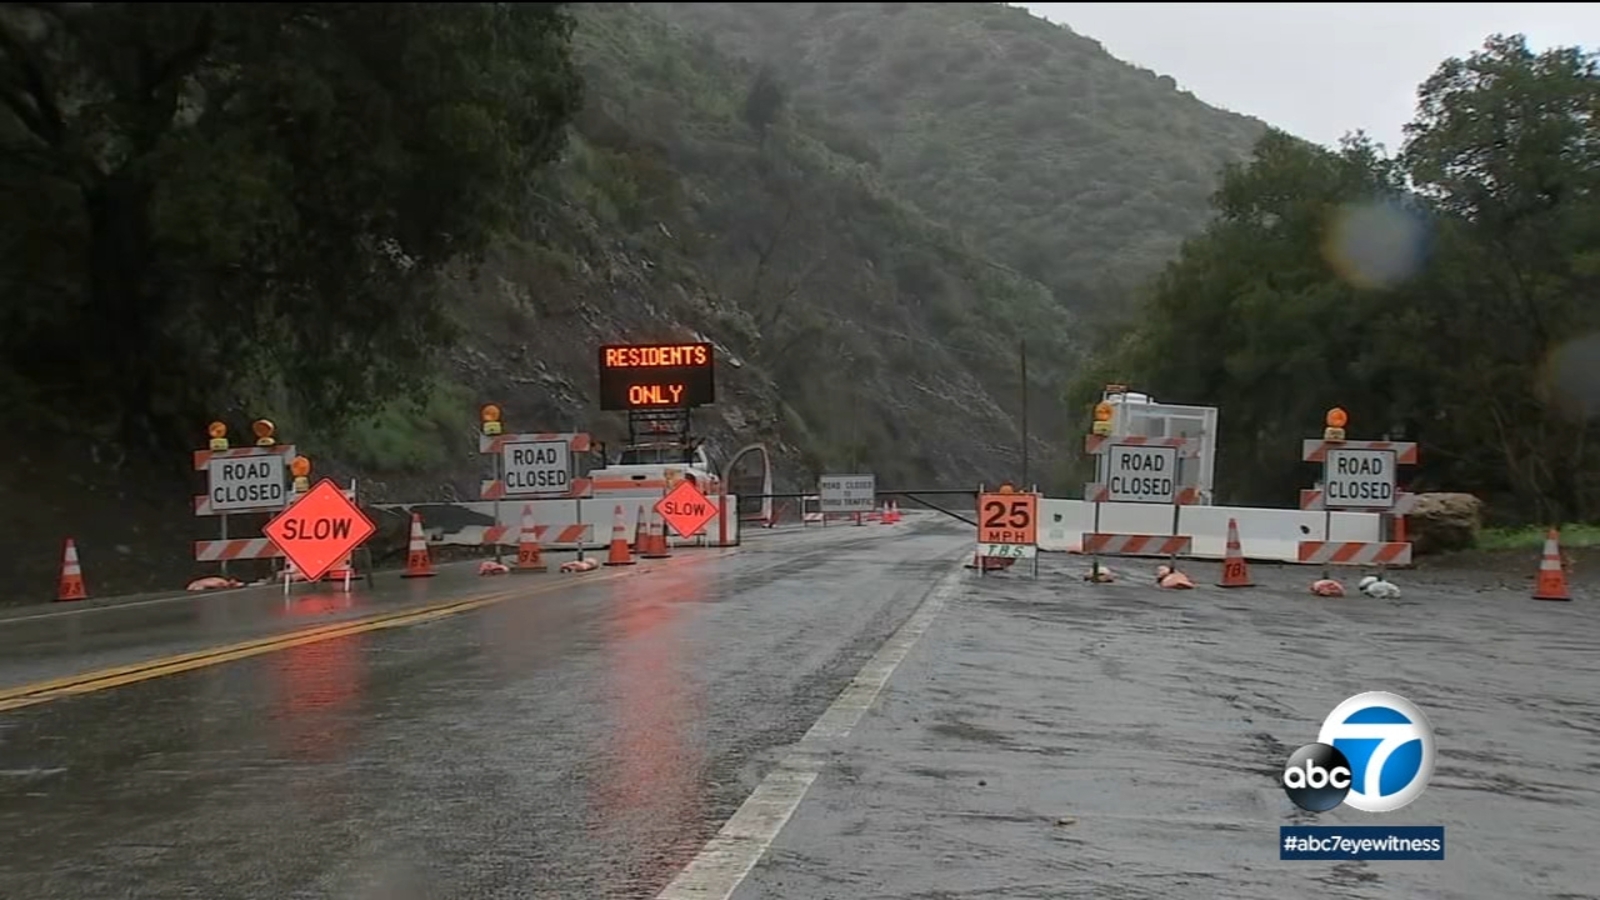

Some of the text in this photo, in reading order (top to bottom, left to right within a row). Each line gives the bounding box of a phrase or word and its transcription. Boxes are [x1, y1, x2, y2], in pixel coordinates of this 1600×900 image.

[606, 345, 707, 367] RESIDENTS
[629, 385, 683, 405] ONLY
[513, 448, 557, 466] ROAD
[1120, 453, 1165, 472] ROAD
[1336, 457, 1383, 475] ROAD
[223, 461, 271, 481] ROAD
[505, 470, 567, 488] CLOSED
[213, 483, 282, 503] CLOSED
[1110, 476, 1172, 496] CLOSED
[1328, 481, 1391, 500] CLOSED
[664, 501, 705, 516] SLOW
[984, 501, 1030, 529] 25
[282, 517, 353, 541] SLOW
[988, 531, 1026, 542] MPH
